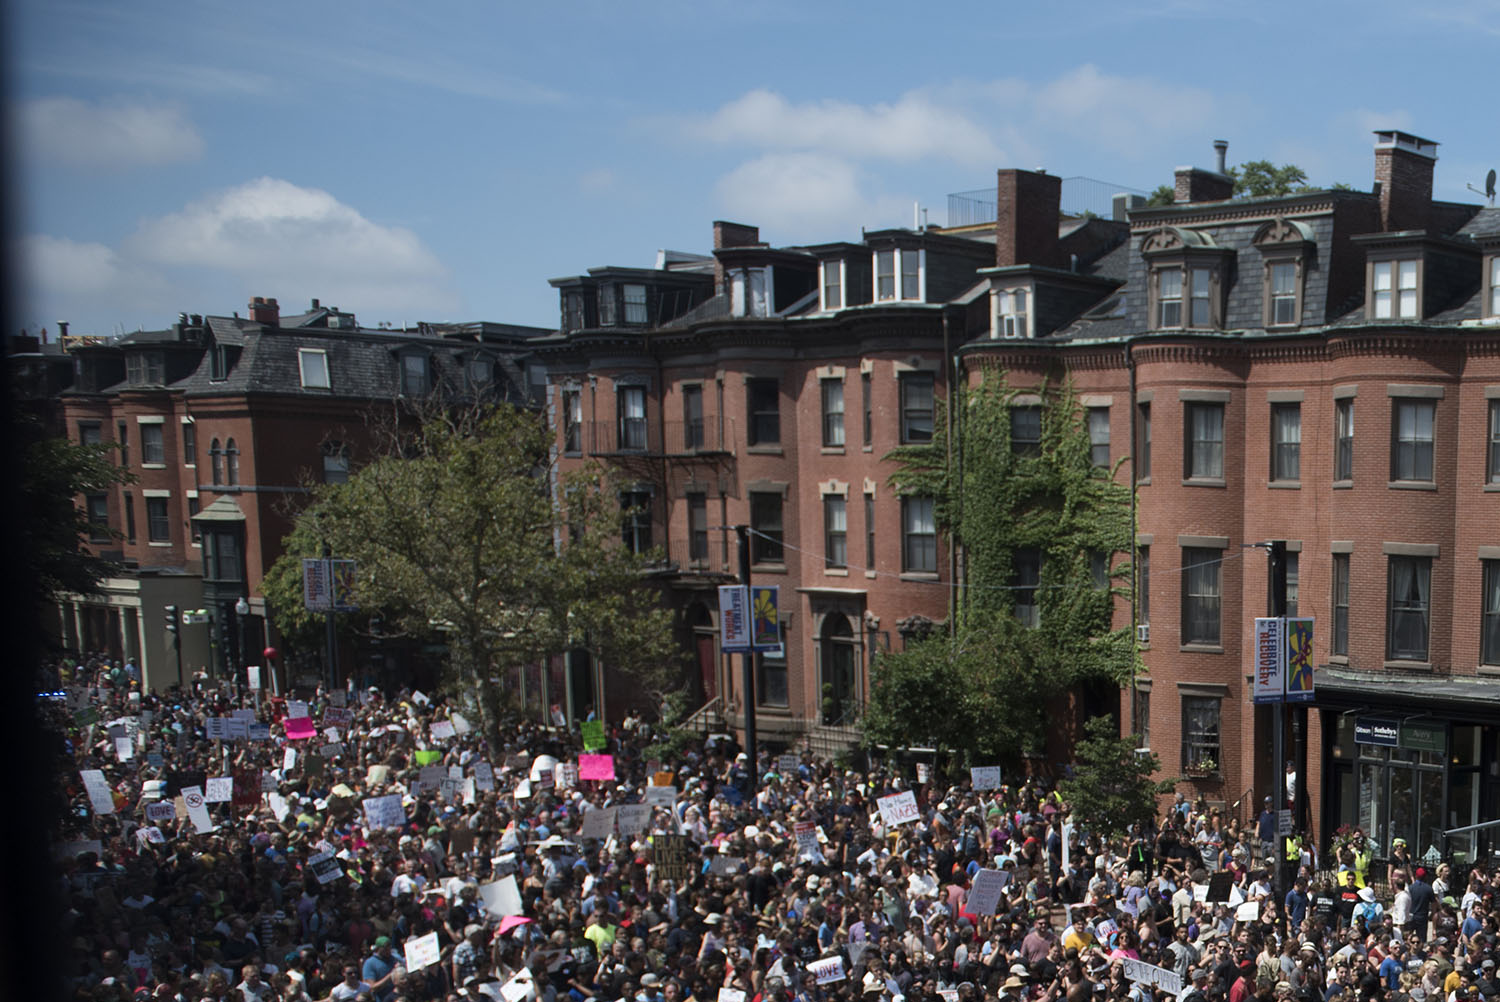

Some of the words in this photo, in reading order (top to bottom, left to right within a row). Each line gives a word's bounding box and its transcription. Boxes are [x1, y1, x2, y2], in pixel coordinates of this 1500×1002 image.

[1259, 631, 1270, 687] RECOVERY
[1268, 619, 1279, 678] CELEBRATE
[815, 963, 838, 979] LOVE
